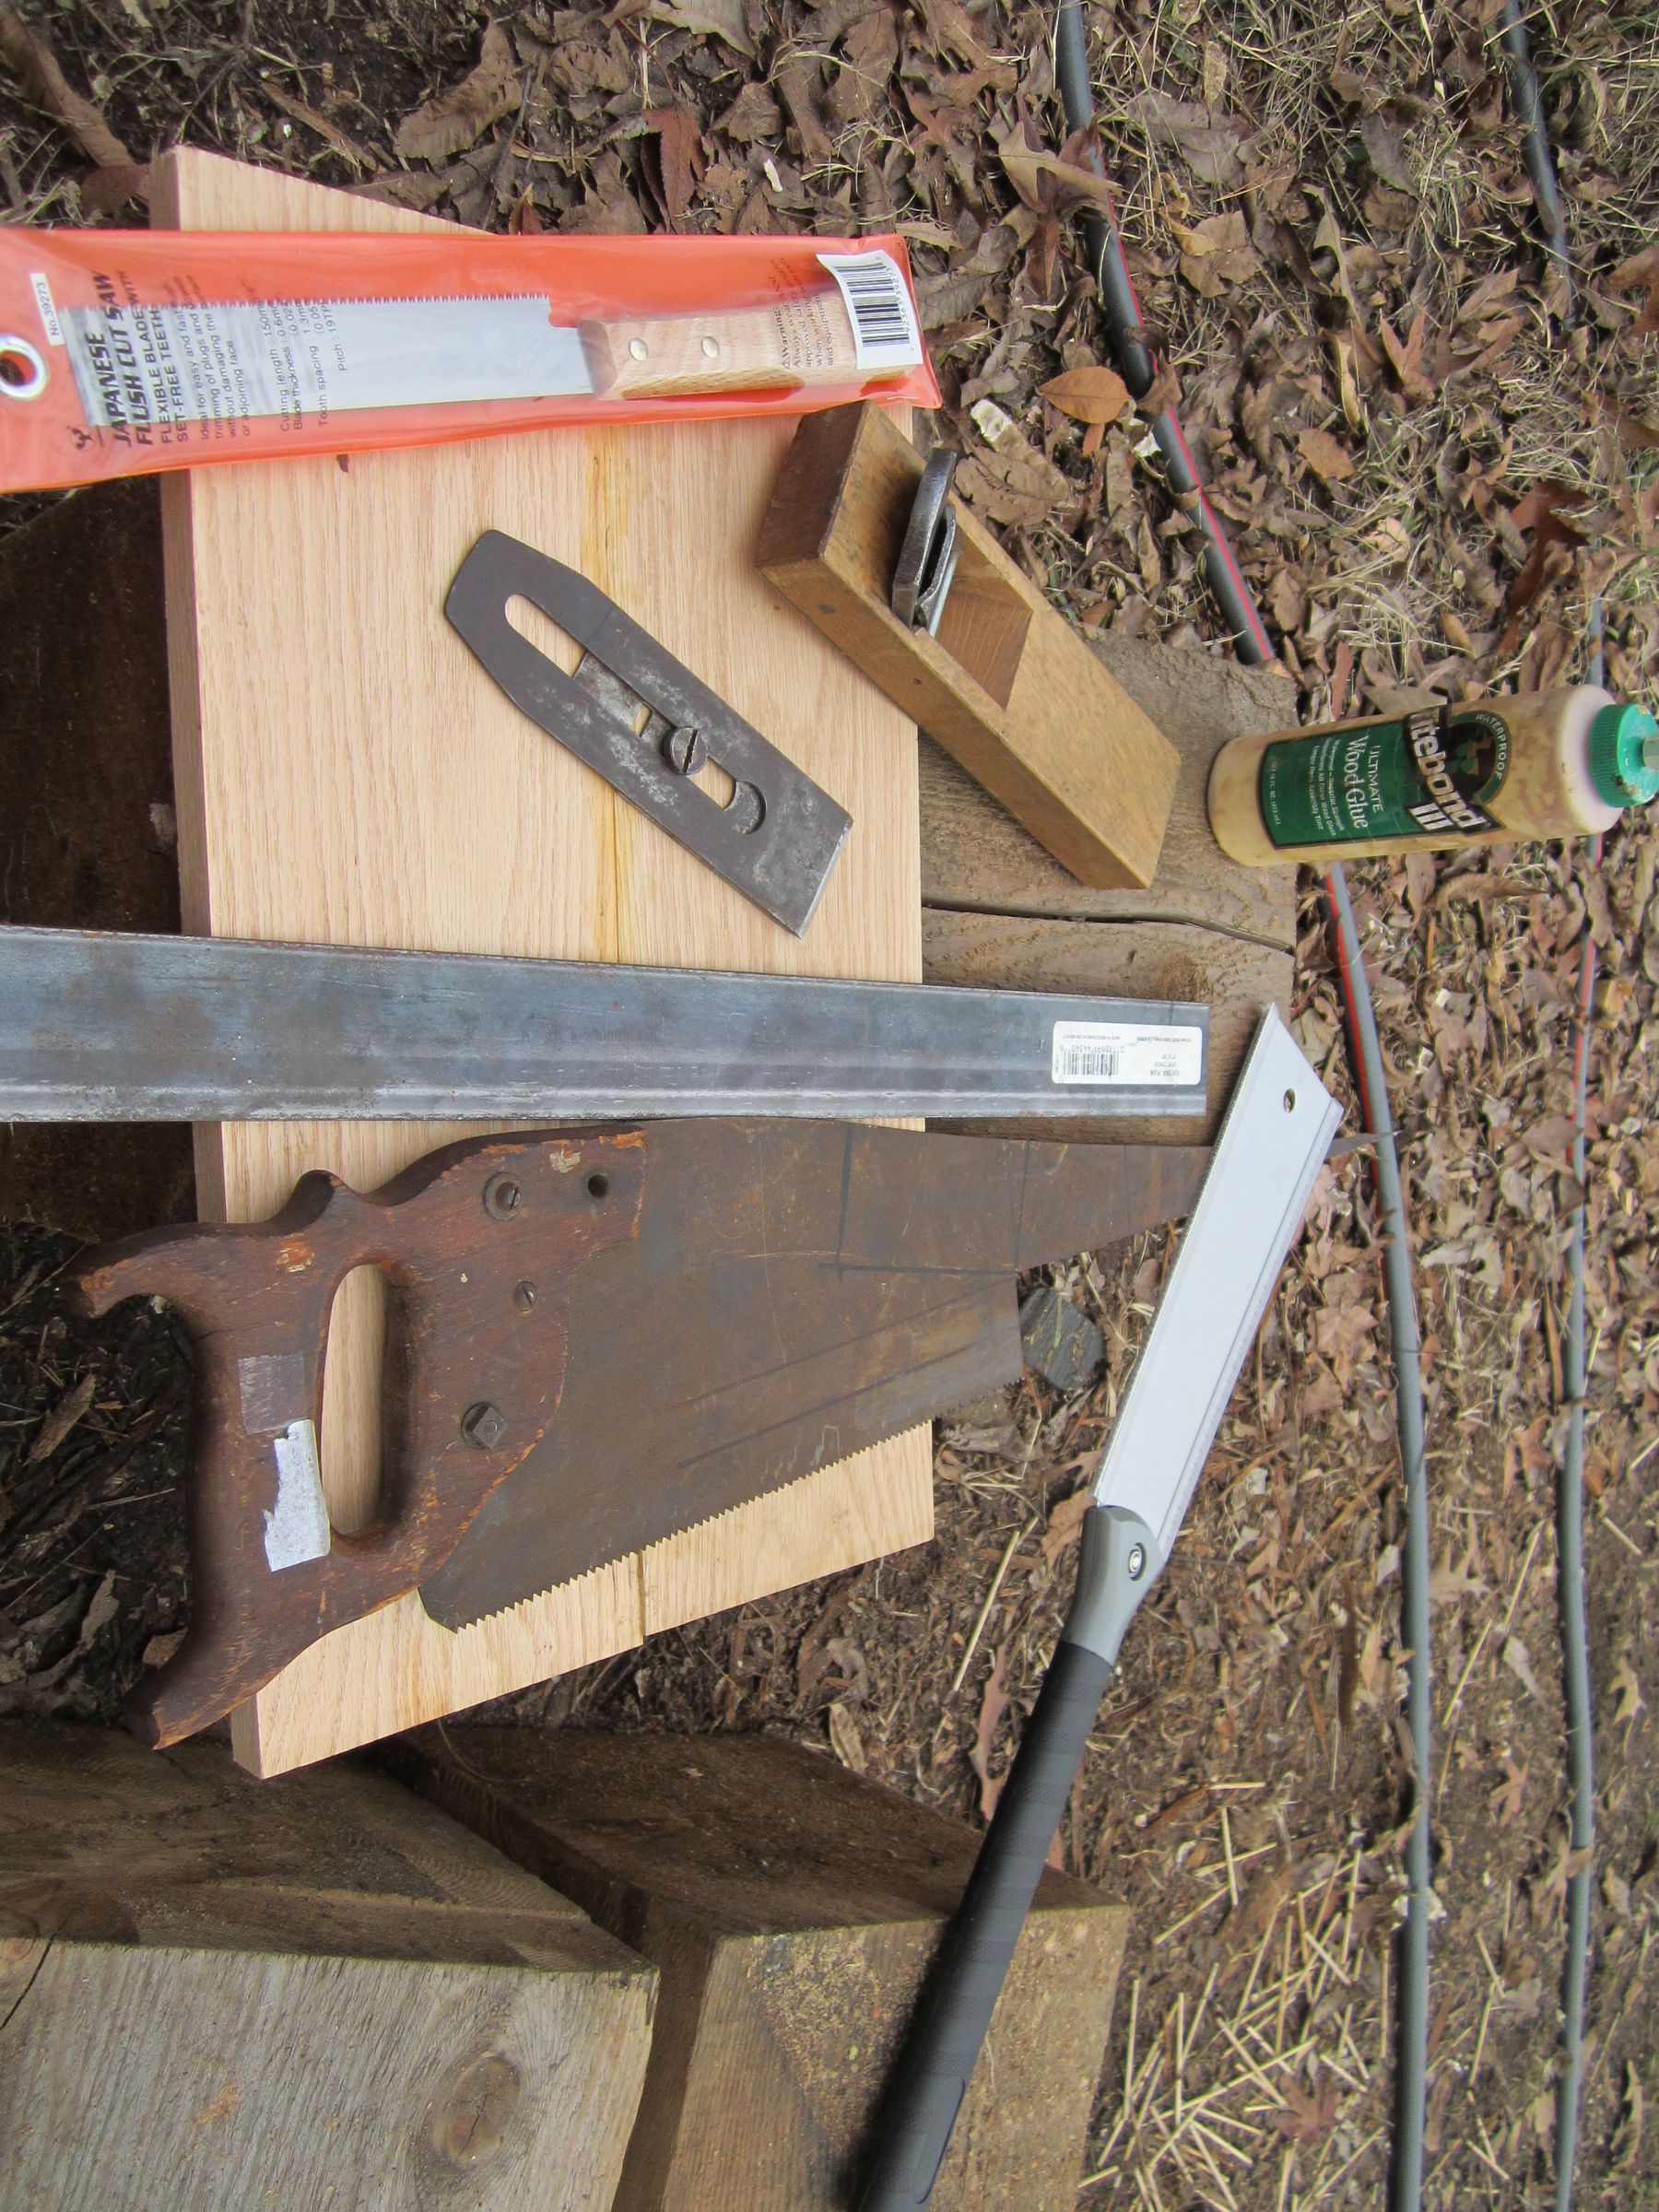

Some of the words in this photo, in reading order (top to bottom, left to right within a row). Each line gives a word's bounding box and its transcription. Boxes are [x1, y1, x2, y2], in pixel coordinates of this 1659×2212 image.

[91, 270, 124, 321] SAW
[118, 271, 140, 305] WITH
[887, 267, 902, 296] 39273
[36, 281, 60, 336] No.39273
[174, 310, 188, 332] fast
[188, 313, 202, 335] and
[203, 313, 216, 331] the
[783, 304, 794, 326] wear
[790, 292, 803, 318] safety
[803, 295, 818, 335] working
[899, 300, 911, 332] 92363
[109, 325, 136, 367] CUT
[133, 310, 157, 362] BLADE
[151, 310, 172, 359] TEETH
[181, 335, 194, 357] and
[772, 306, 790, 357] Warning:
[789, 329, 802, 369] Always
[799, 321, 813, 368] approved
[196, 338, 214, 370] plugs
[211, 335, 232, 392] damaging
[268, 348, 288, 385] length
[283, 347, 300, 396] thickness
[308, 346, 327, 391] spacing
[333, 344, 347, 371] Pitch
[811, 338, 824, 366] when
[825, 347, 834, 366] and
[85, 333, 132, 447] JAPANESE
[189, 361, 205, 388] easy
[204, 373, 216, 383] of
[233, 369, 251, 420] adjoining
[124, 374, 153, 445] FLUSH
[148, 369, 172, 443] FLEXIBLE
[164, 365, 188, 442] SET-FREE
[195, 393, 207, 408] for
[207, 388, 224, 439] trimming
[225, 396, 237, 437] without
[276, 389, 290, 431] Cutting
[291, 400, 303, 429] Blade
[317, 394, 329, 427] Tooth
[198, 412, 210, 440] Ideal
[241, 424, 251, 436] or
[1344, 735, 1370, 786] Wood
[1476, 713, 1508, 780] WATERPROOF
[1368, 745, 1383, 814] ULTIMATE
[1410, 708, 1487, 829] Titebond
[1346, 788, 1369, 829] Glue
